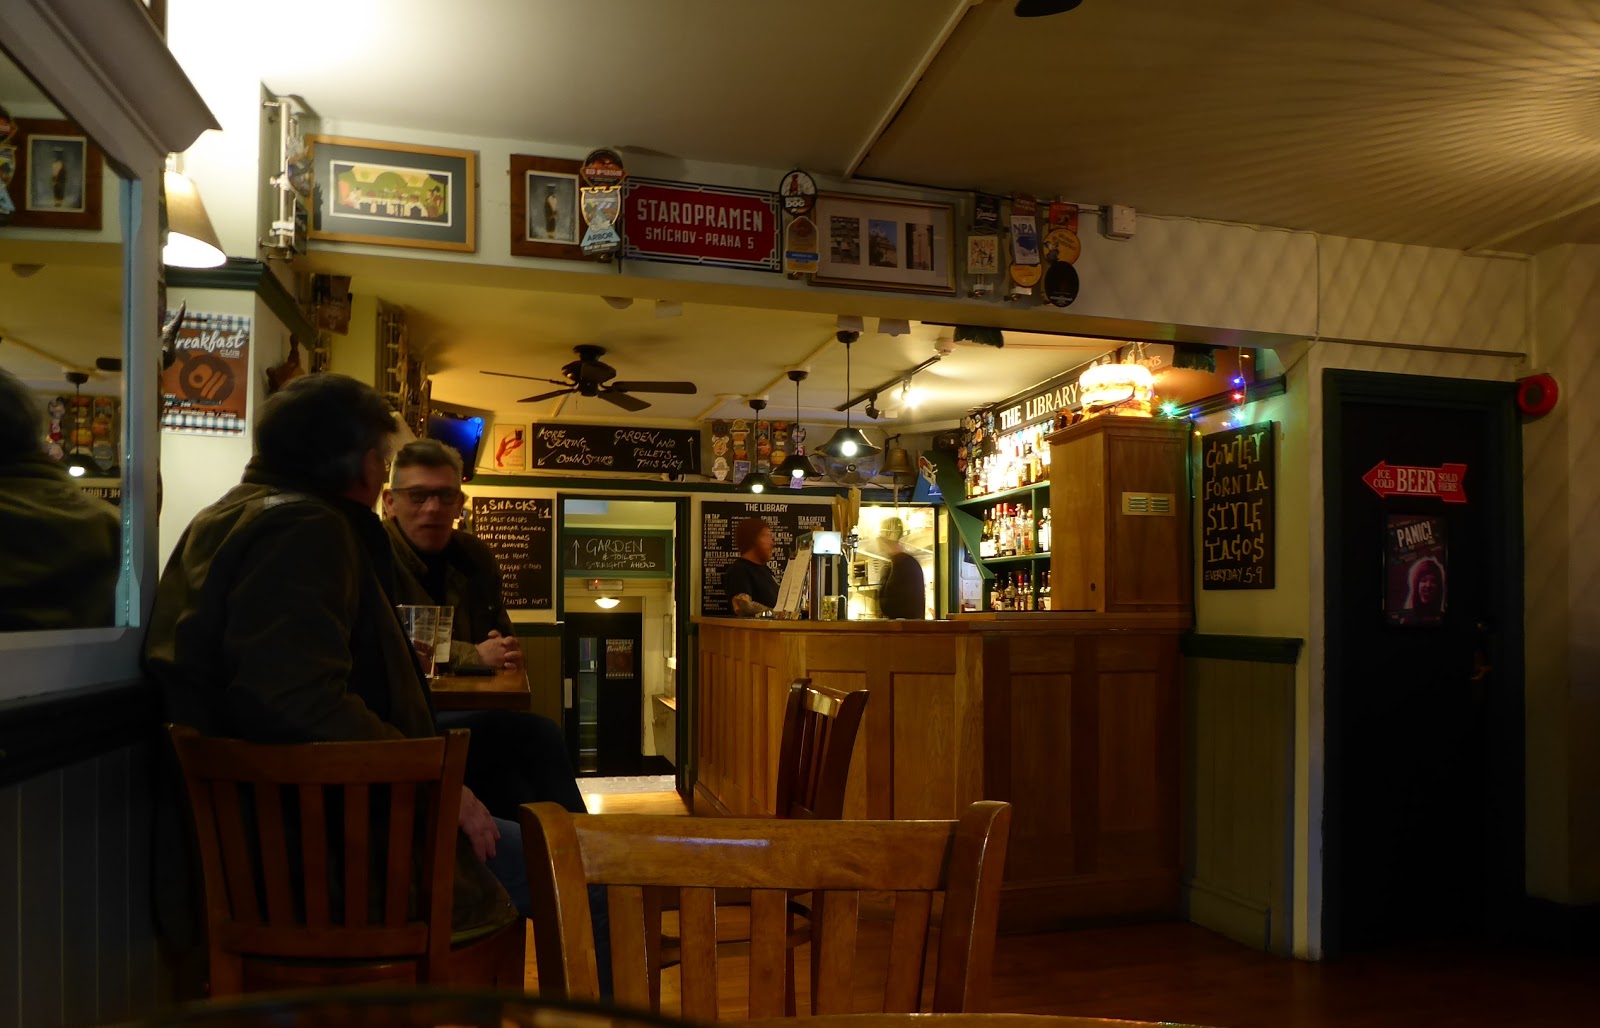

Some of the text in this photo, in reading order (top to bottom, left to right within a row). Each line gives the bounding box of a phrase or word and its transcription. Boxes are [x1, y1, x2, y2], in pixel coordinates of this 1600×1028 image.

[637, 198, 763, 232] STAROPRAMEN
[1013, 223, 1034, 234] NPA
[705, 233, 741, 248] PRAHA
[748, 236, 754, 249] 5
[174, 329, 245, 353] reakfast
[1000, 381, 1079, 430] THE LIBRARY
[537, 427, 566, 440] MORE
[614, 430, 675, 448] GARDEN AND
[556, 454, 613, 466] DOWN STAIRS
[636, 459, 683, 470] THIS WAY
[1378, 469, 1391, 479] ICE
[1396, 468, 1436, 493] BEER
[1438, 472, 1458, 482] SOLD
[1373, 478, 1395, 489] COLD
[1438, 482, 1458, 492] HERE
[489, 499, 537, 511] SNACKS
[745, 503, 788, 512] THE LIBRARY
[1207, 498, 1263, 535] STYLE
[477, 533, 493, 541] MINI
[1396, 520, 1432, 548] PANIC!
[586, 538, 643, 556] GARDEN
[1205, 532, 1264, 563] TACOS
[586, 561, 656, 570] STRAIGHT AHEAD
[1205, 566, 1263, 583] EVERYDAY 5-9
